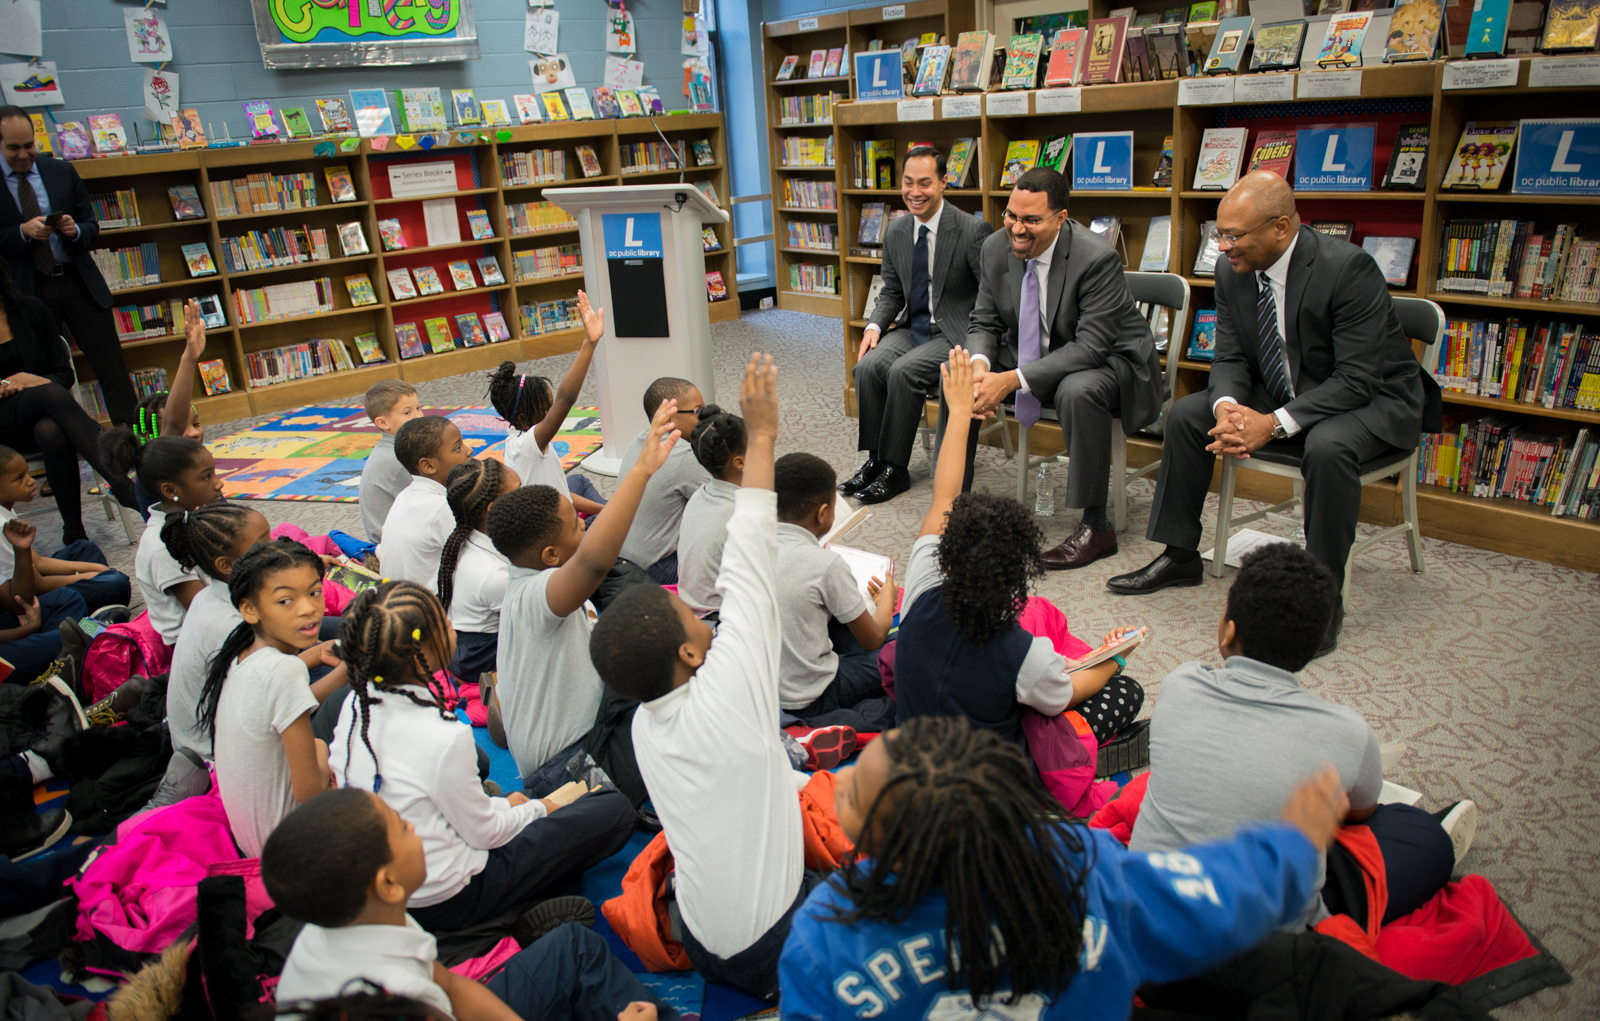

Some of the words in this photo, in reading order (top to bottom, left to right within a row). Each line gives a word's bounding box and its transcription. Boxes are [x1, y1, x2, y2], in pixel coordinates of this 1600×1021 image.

[884, 8, 904, 17] Fiction
[873, 58, 887, 87] L
[1093, 141, 1111, 173] L
[1252, 144, 1292, 162] CODERS
[1321, 135, 1346, 171] L
[1550, 130, 1582, 172] L
[1085, 176, 1104, 185] public
[1104, 176, 1127, 185] library
[1311, 176, 1335, 185] public
[1337, 175, 1367, 185] library
[1536, 176, 1568, 187] public
[625, 218, 643, 247] L
[637, 249, 660, 257] library
